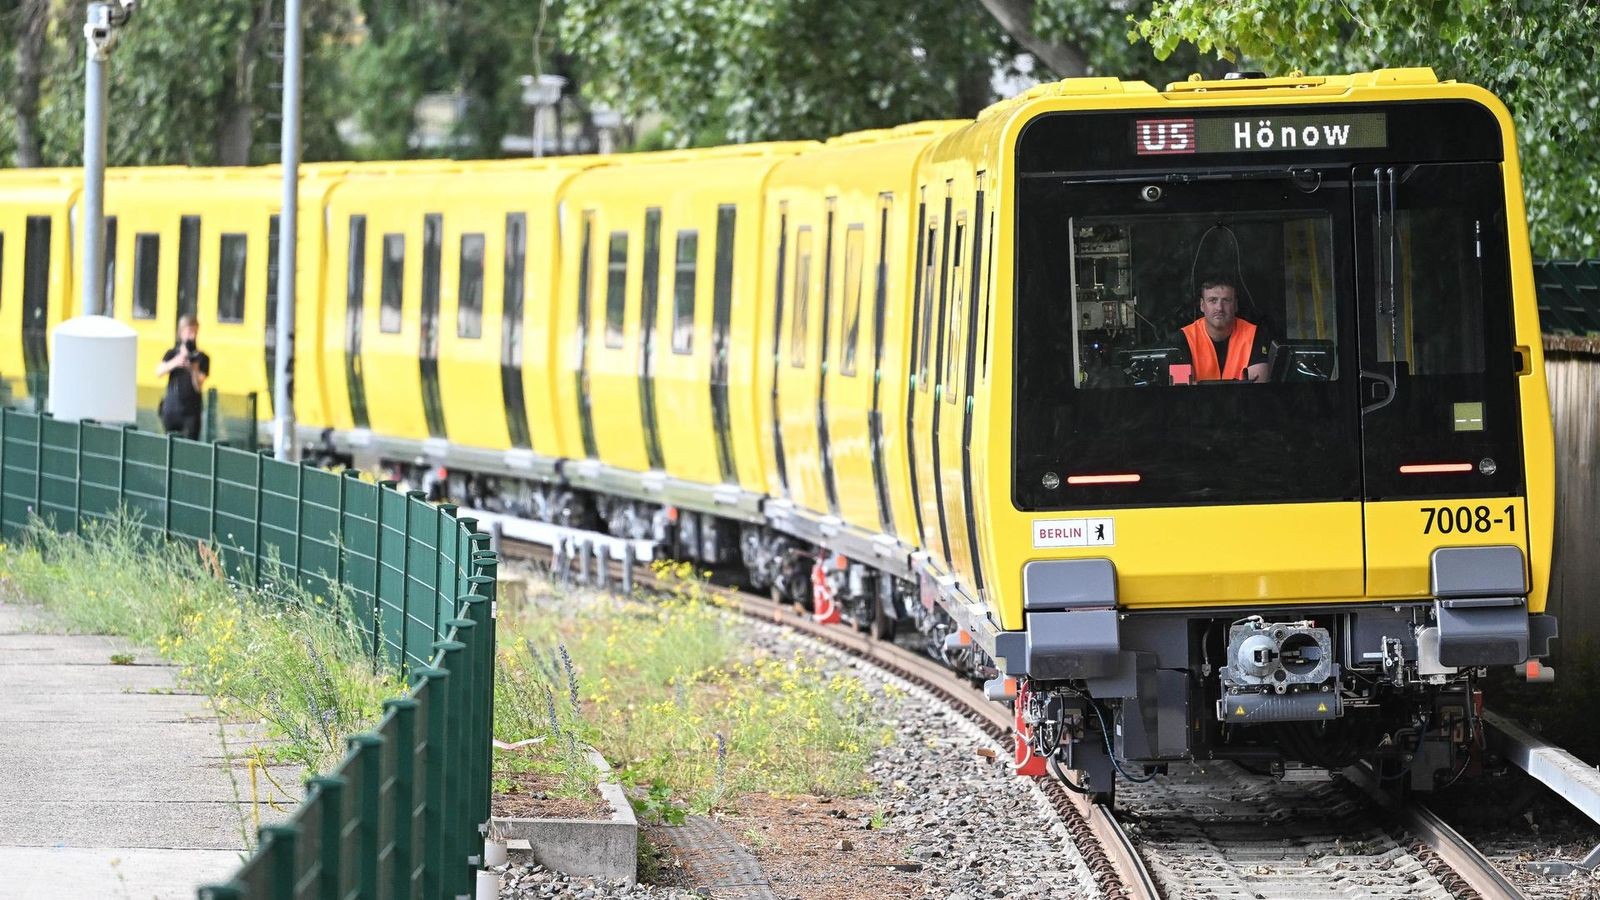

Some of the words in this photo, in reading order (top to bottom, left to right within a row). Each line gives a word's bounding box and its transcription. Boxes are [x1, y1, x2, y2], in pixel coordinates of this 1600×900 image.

[1142, 123, 1188, 150] U5
[1234, 120, 1350, 149] Hönow
[1039, 527, 1082, 539] BERLIN
[1420, 505, 1515, 535] 7008-1
